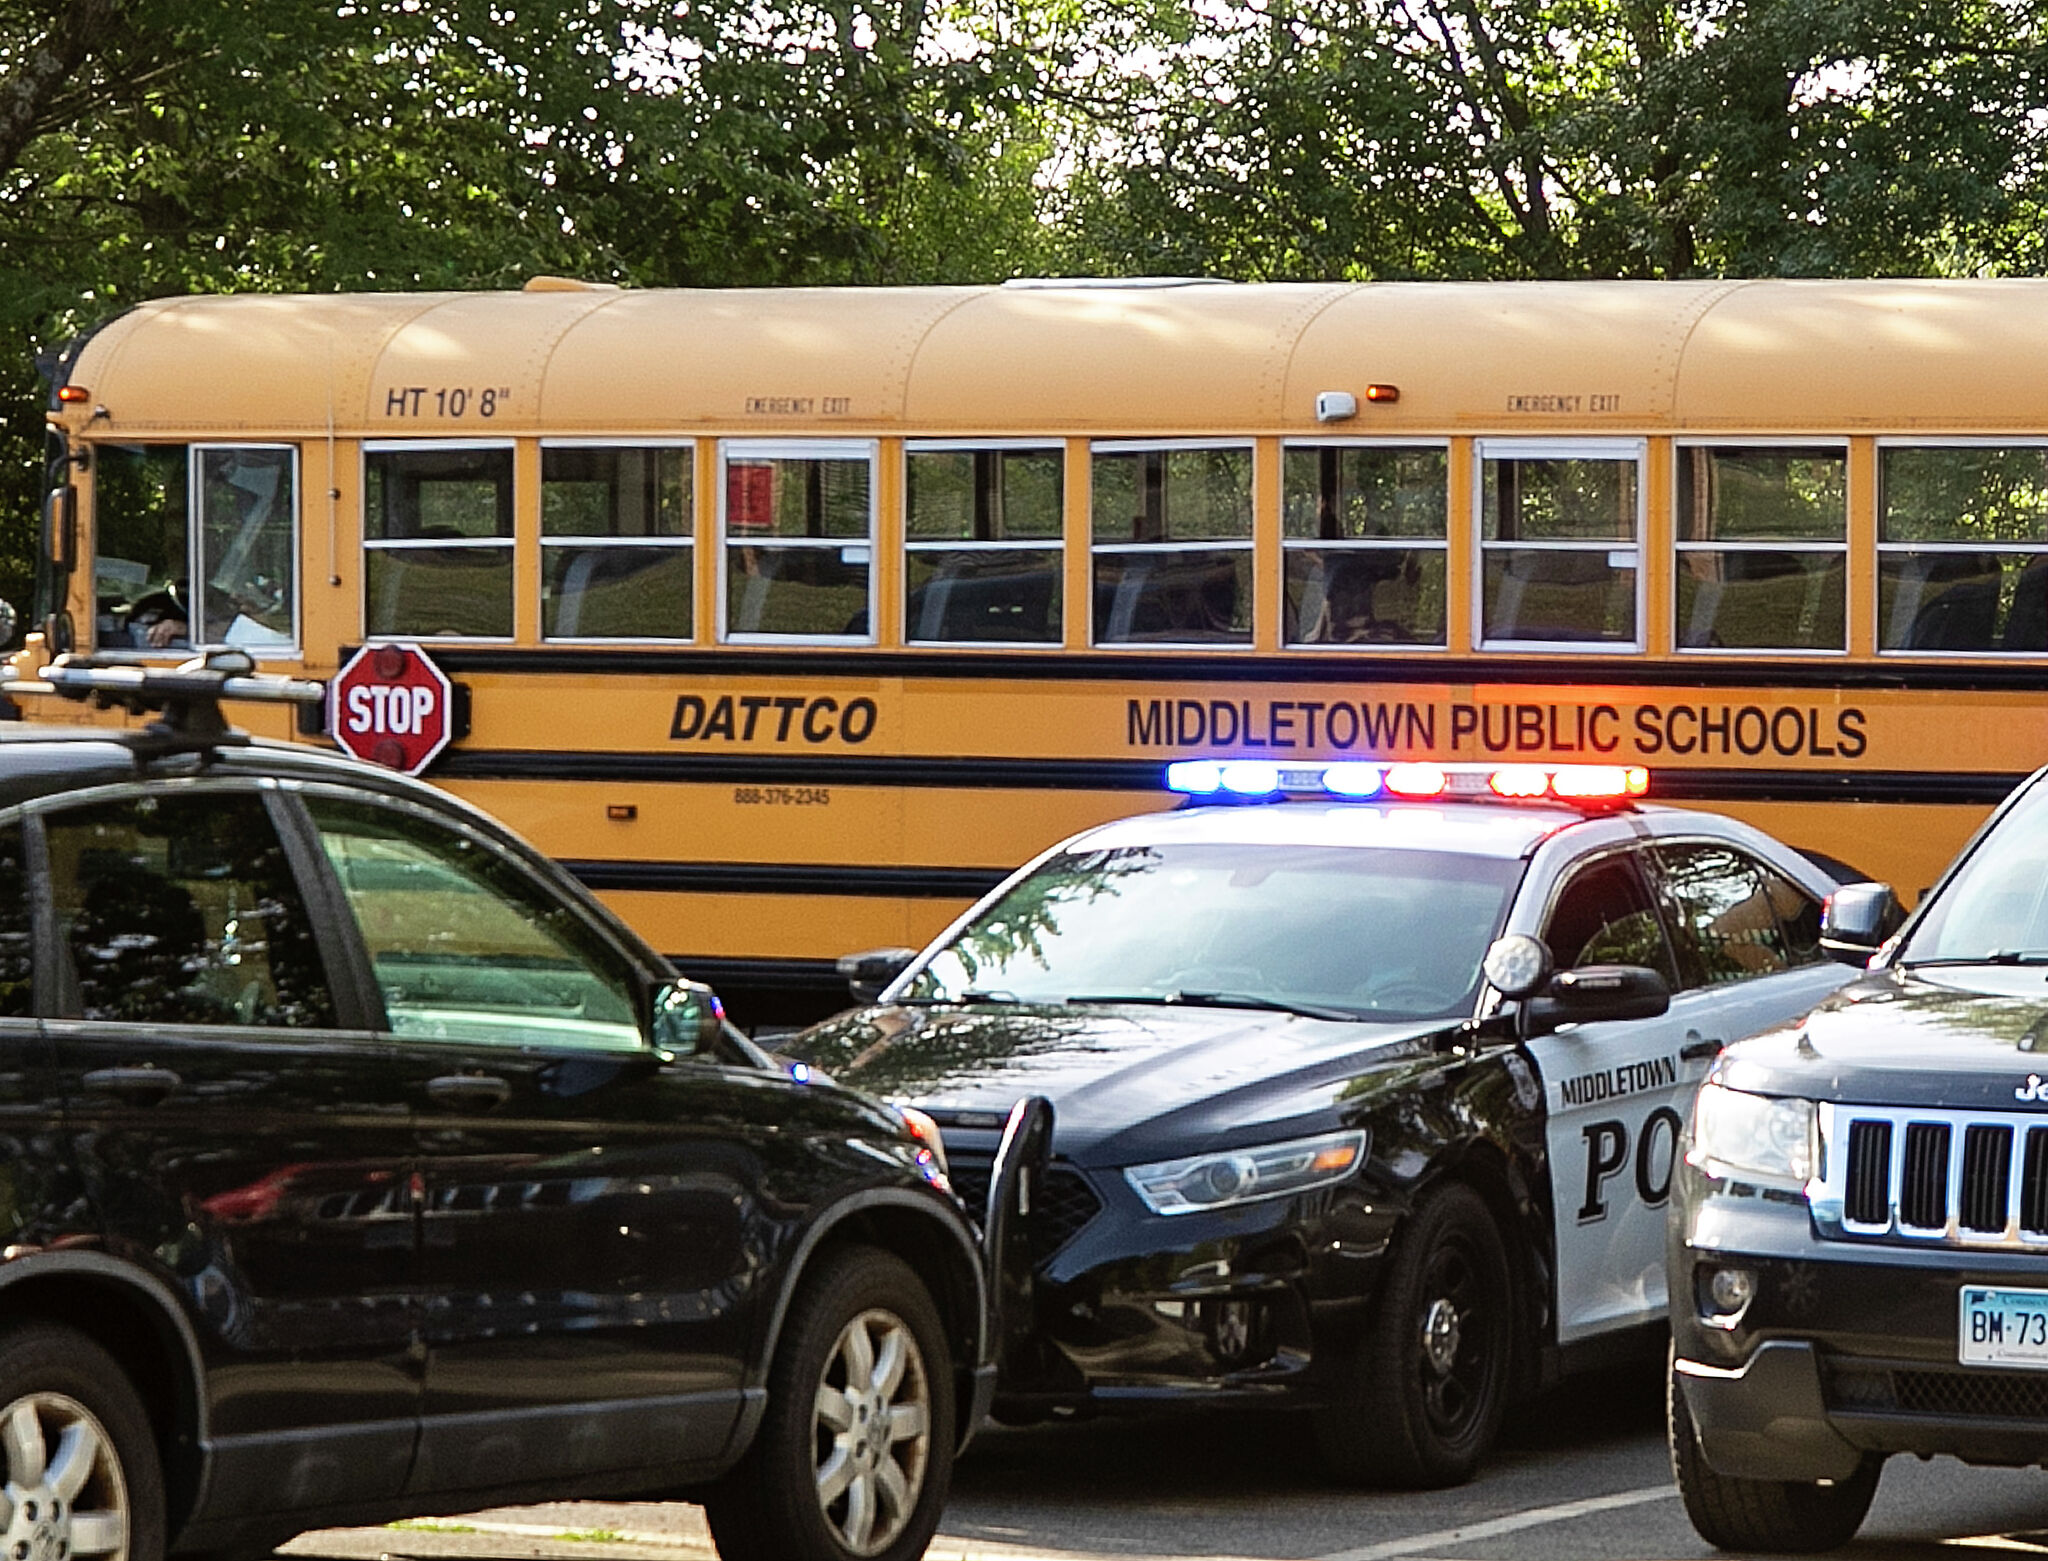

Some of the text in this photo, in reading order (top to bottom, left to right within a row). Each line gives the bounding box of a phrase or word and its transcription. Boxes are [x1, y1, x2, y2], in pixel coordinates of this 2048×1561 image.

[386, 387, 510, 418] HT 10' 8"
[745, 396, 850, 414] EMERGENCY EXIT
[1507, 394, 1620, 412] EMERGENCY EXIT
[348, 685, 434, 734] STOP
[669, 695, 878, 743] DATTCO
[1128, 699, 1868, 758] MIDDLETOWN PUBLIC SCHOOLS
[735, 788, 830, 805] 888-376-2345
[1561, 1055, 1677, 1107] MIDDLETOWN
